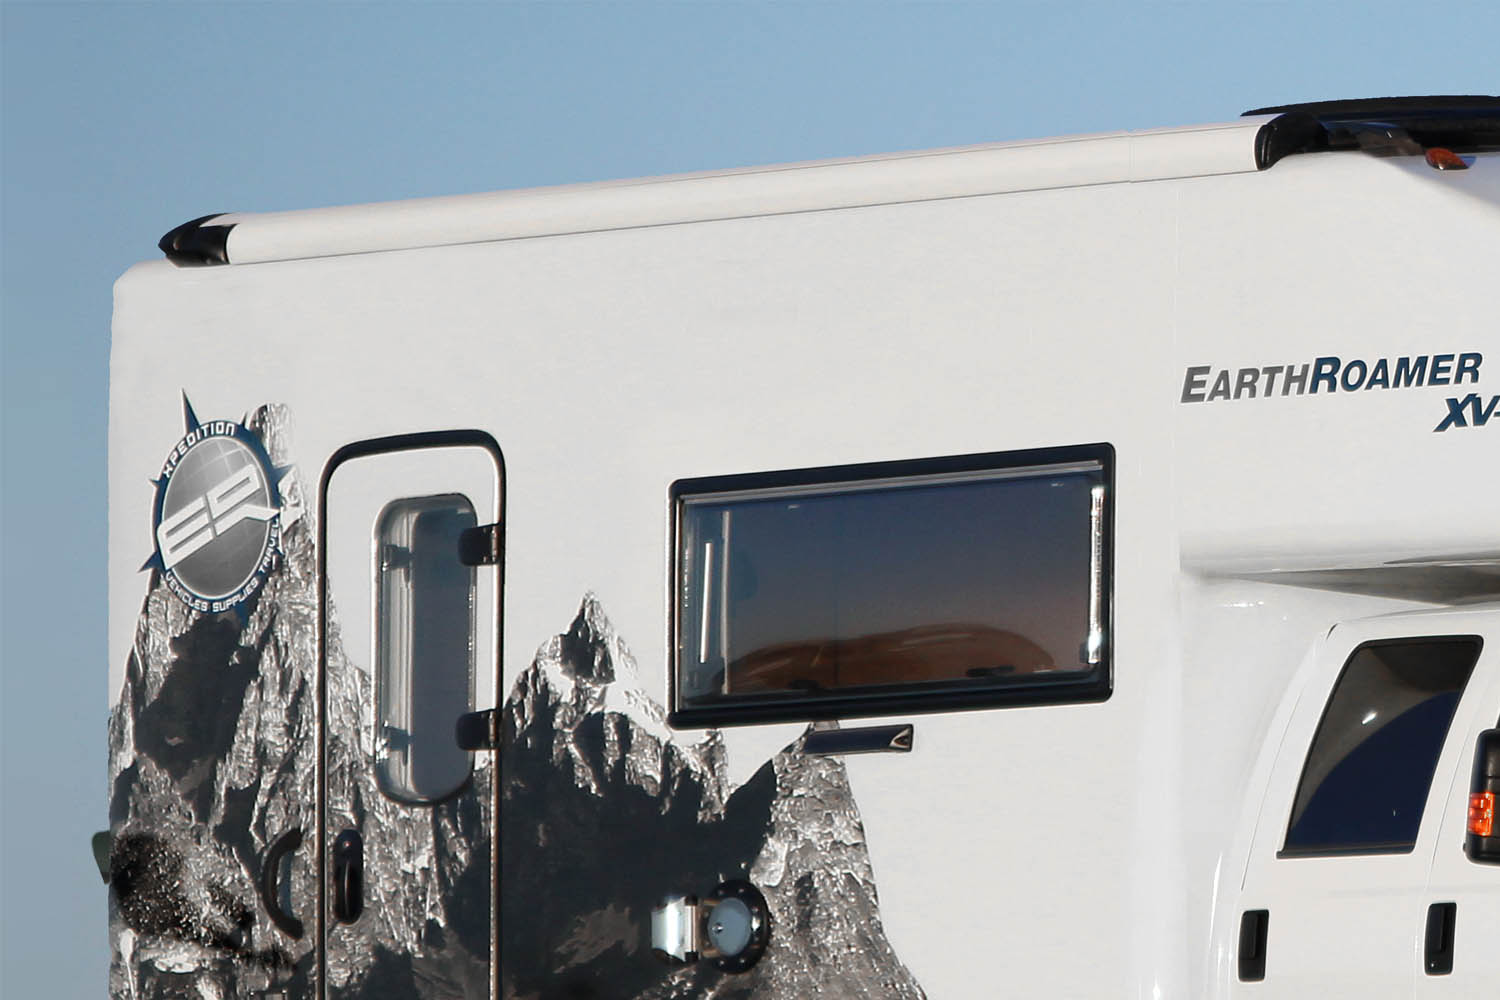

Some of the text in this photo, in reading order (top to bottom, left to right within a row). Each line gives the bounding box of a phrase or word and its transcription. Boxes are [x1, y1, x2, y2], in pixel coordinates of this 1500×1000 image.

[162, 421, 236, 479] XPEDITION
[165, 571, 209, 612] VEHICLES
[211, 577, 260, 613] SUPPLIES
